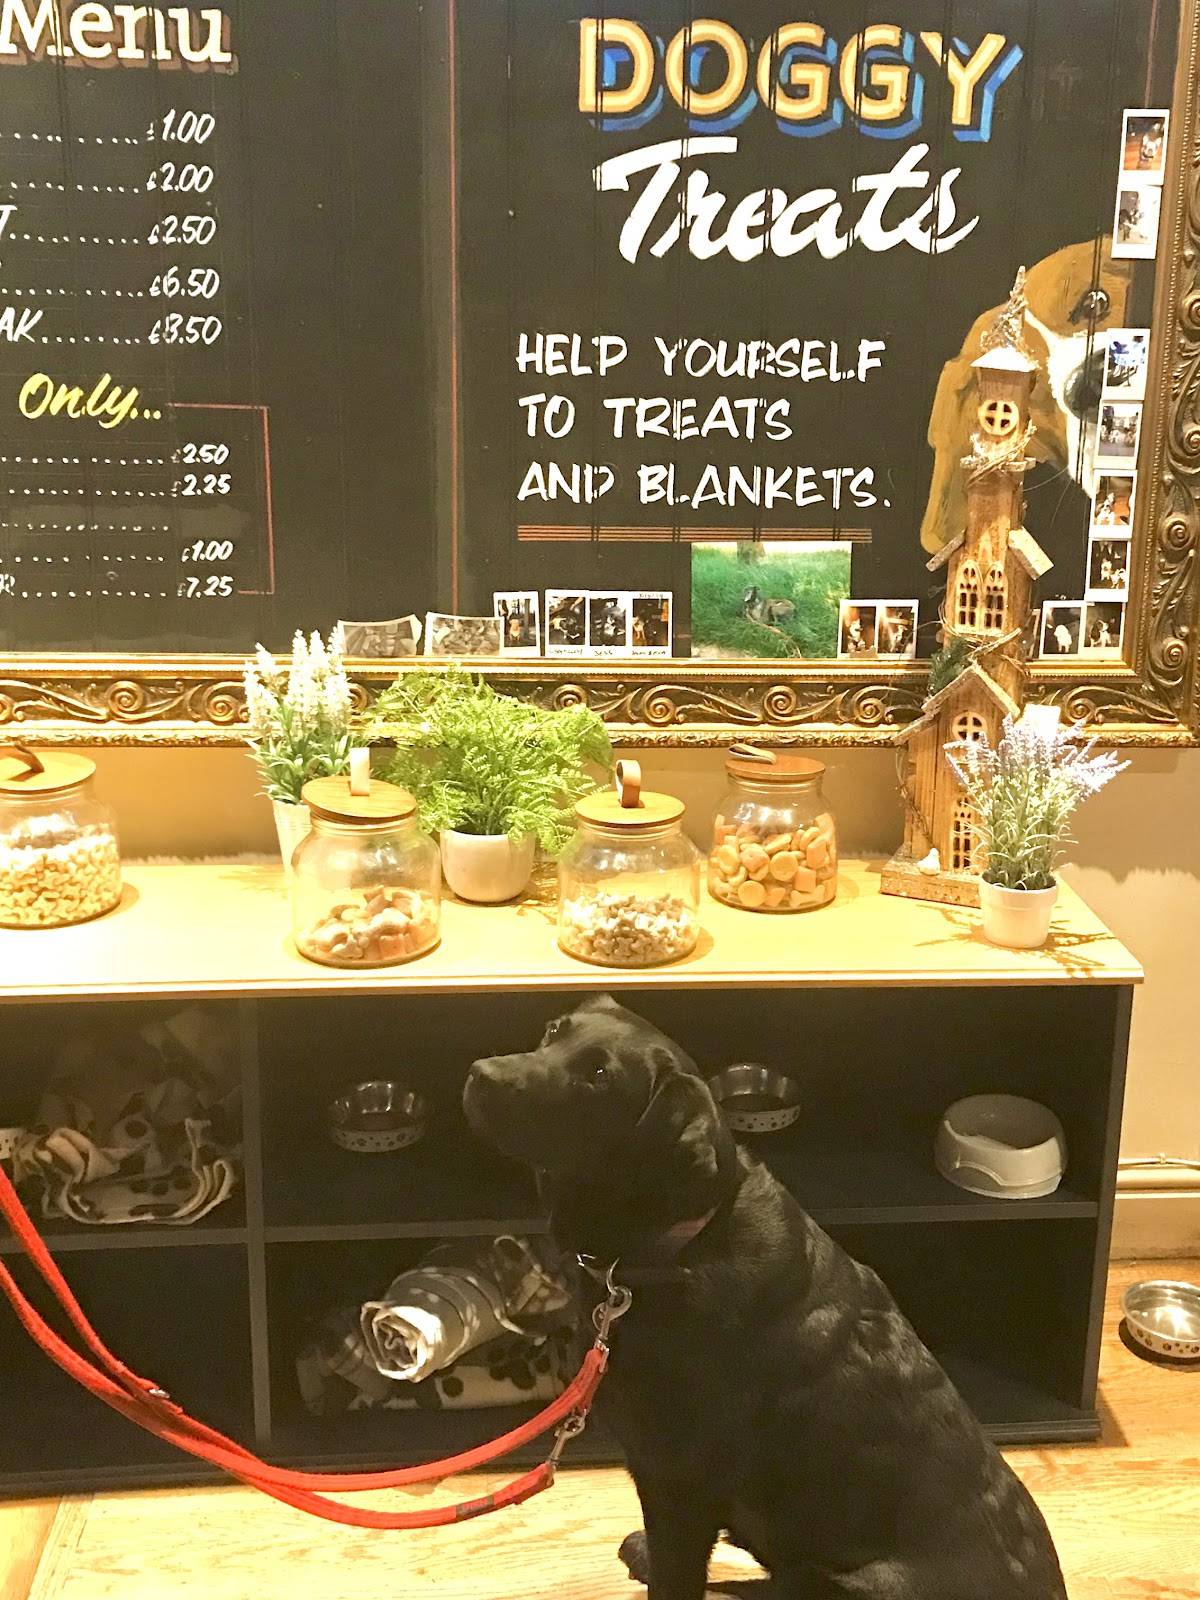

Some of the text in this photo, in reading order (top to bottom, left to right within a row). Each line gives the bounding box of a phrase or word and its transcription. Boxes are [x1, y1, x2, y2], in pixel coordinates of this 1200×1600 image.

[0, 0, 233, 62] Menu
[579, 18, 1008, 128] DOGGY
[147, 162, 213, 193] £2.00
[593, 137, 979, 264] Treats
[148, 216, 217, 245] £2.50
[150, 266, 220, 299] £6.50
[516, 333, 886, 383] HELP YOURSELF
[518, 393, 793, 440] TO TREATS
[517, 462, 892, 509] AND BLANKETS.
